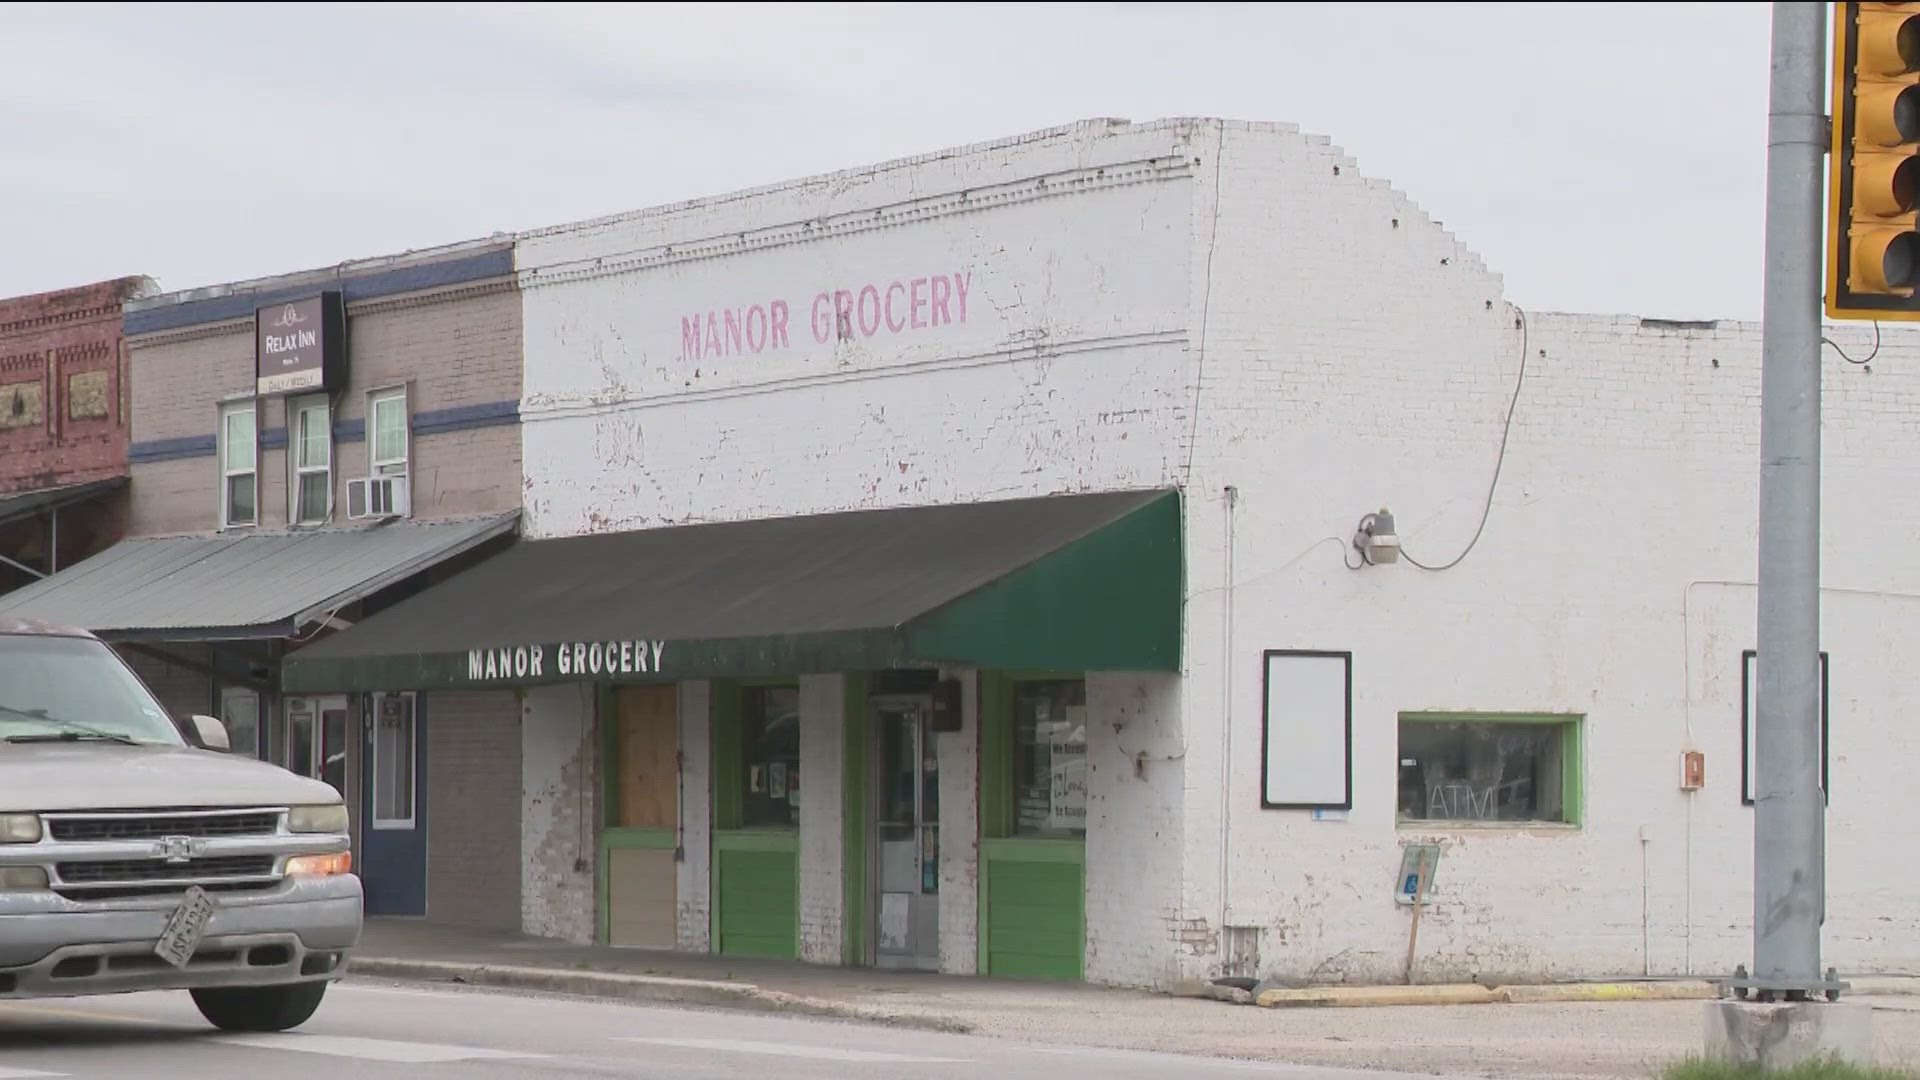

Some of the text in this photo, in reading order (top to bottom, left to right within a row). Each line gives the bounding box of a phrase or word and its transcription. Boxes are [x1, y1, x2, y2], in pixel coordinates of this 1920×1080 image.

[681, 271, 972, 361] MANOR GROCERY
[266, 329, 315, 353] RELAX INN
[468, 639, 664, 680] MANOR GROCERY
[1430, 784, 1494, 819] ATM
